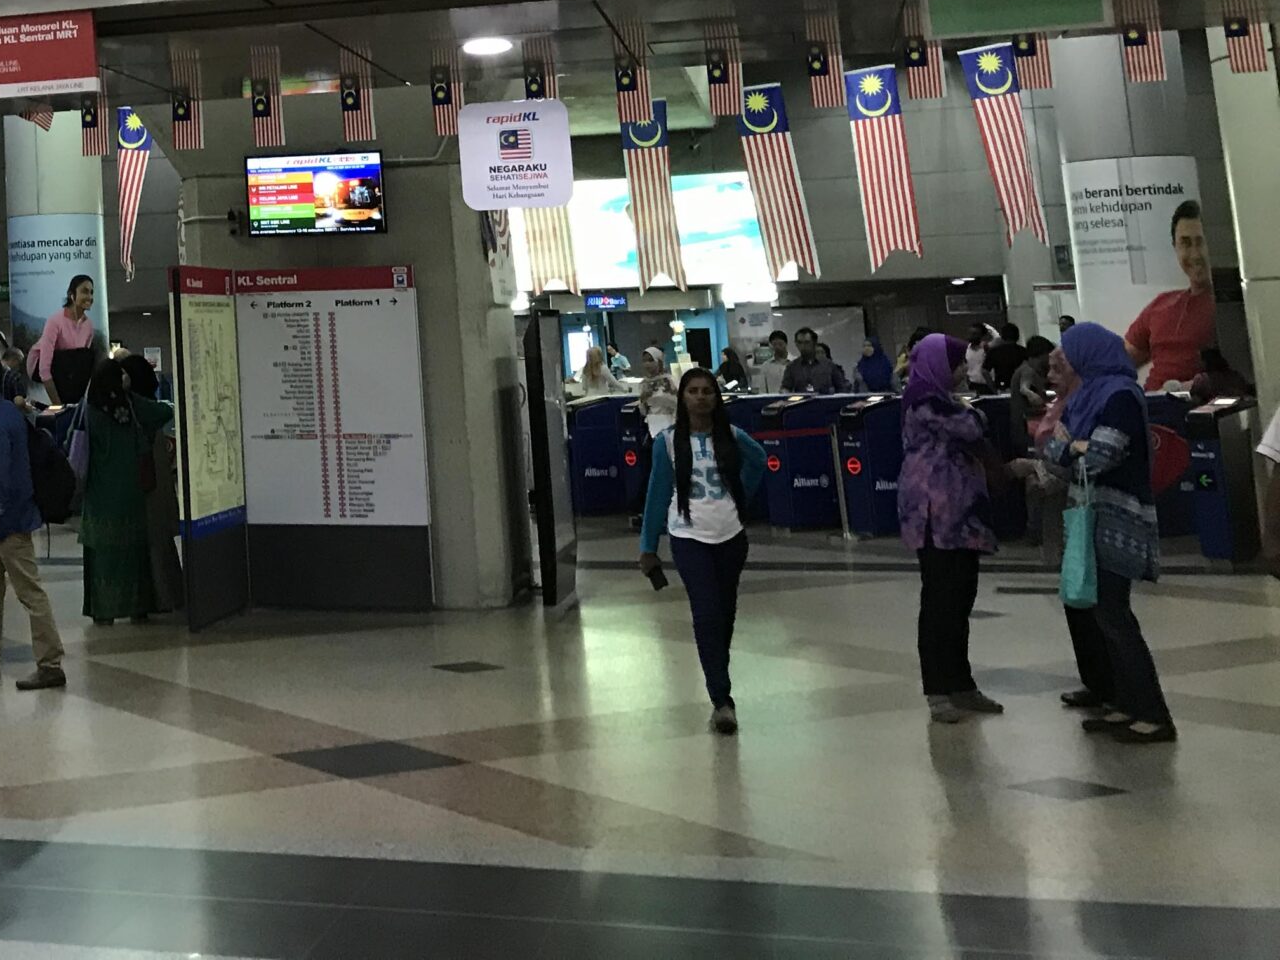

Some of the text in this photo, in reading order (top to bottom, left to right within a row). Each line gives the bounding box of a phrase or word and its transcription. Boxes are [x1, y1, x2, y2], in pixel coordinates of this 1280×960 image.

[21, 23, 60, 33] Monorel
[62, 20, 79, 30] KL,
[4, 35, 18, 44] KL
[20, 32, 54, 43] Sentral
[57, 30, 78, 40] MR1
[486, 112, 540, 125] rapidKL
[489, 163, 547, 174] NEGARAKU
[489, 173, 549, 181] SEHATISEJIWA
[486, 183, 549, 193] Selamat Menyambut
[1085, 185, 1123, 199] berani
[1125, 183, 1184, 197] bertindak
[1089, 201, 1152, 215] kehidupan
[1090, 218, 1128, 229] selesa.
[37, 236, 83, 248] mencabar
[85, 237, 97, 246] diri
[48, 252, 71, 262] yang
[237, 274, 298, 286] KL Sentral
[267, 300, 312, 309] Platform 2
[335, 298, 381, 307] Platform 1
[584, 467, 609, 478] Allianz
[793, 476, 820, 488] Allianz
[875, 480, 898, 491] Allian
